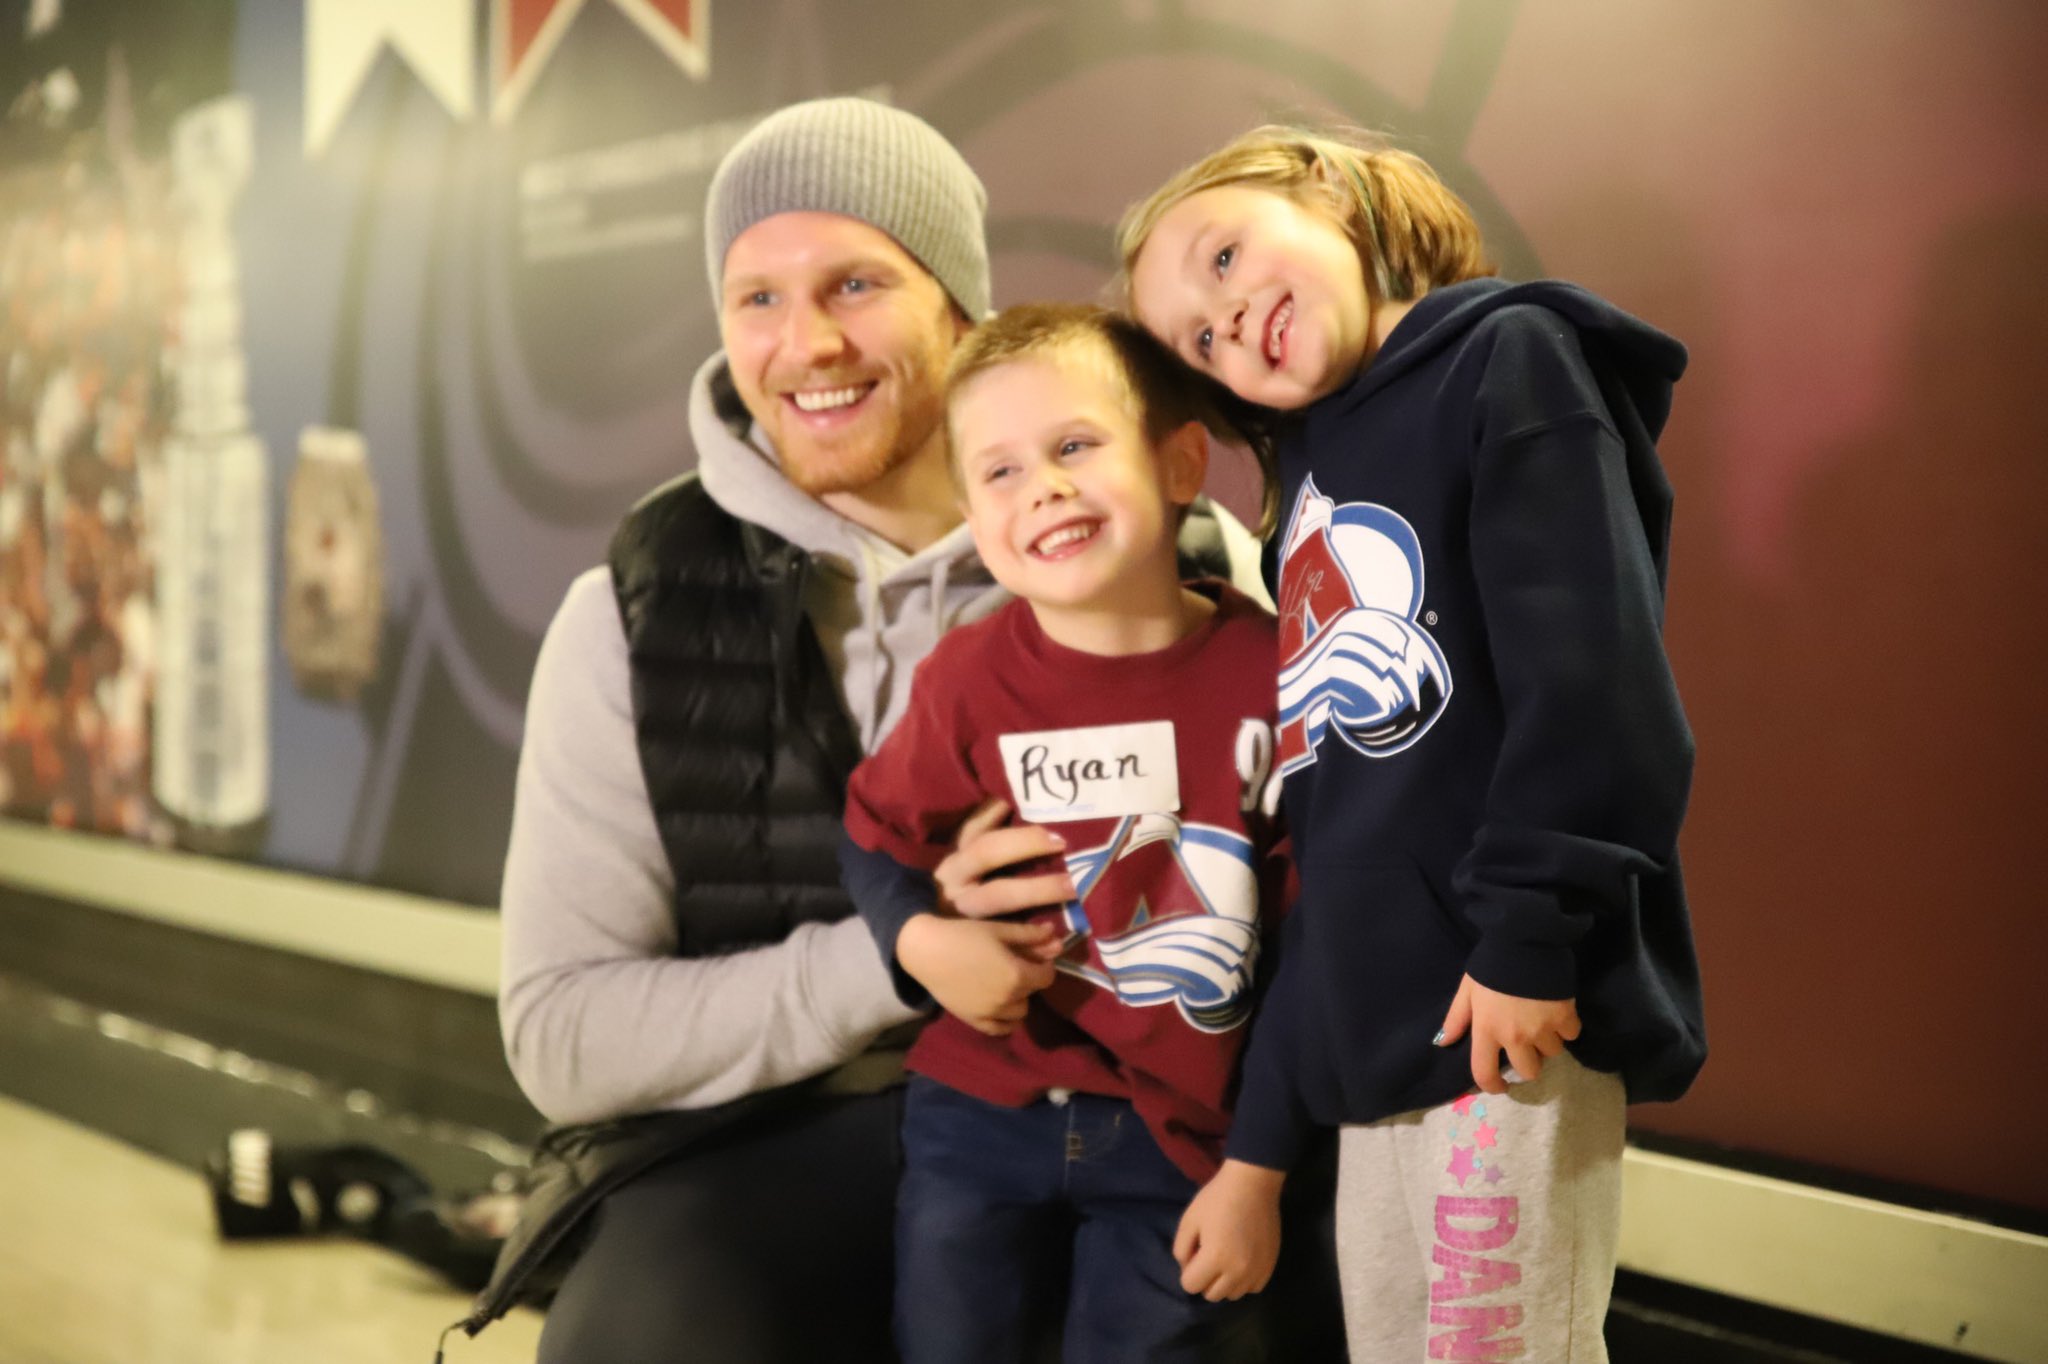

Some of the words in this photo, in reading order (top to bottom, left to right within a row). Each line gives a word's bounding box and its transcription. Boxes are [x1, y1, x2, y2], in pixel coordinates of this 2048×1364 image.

[1020, 744, 1148, 806] Ryan
[1235, 717, 1283, 817] 9
[1427, 1194, 1527, 1364] DAN
